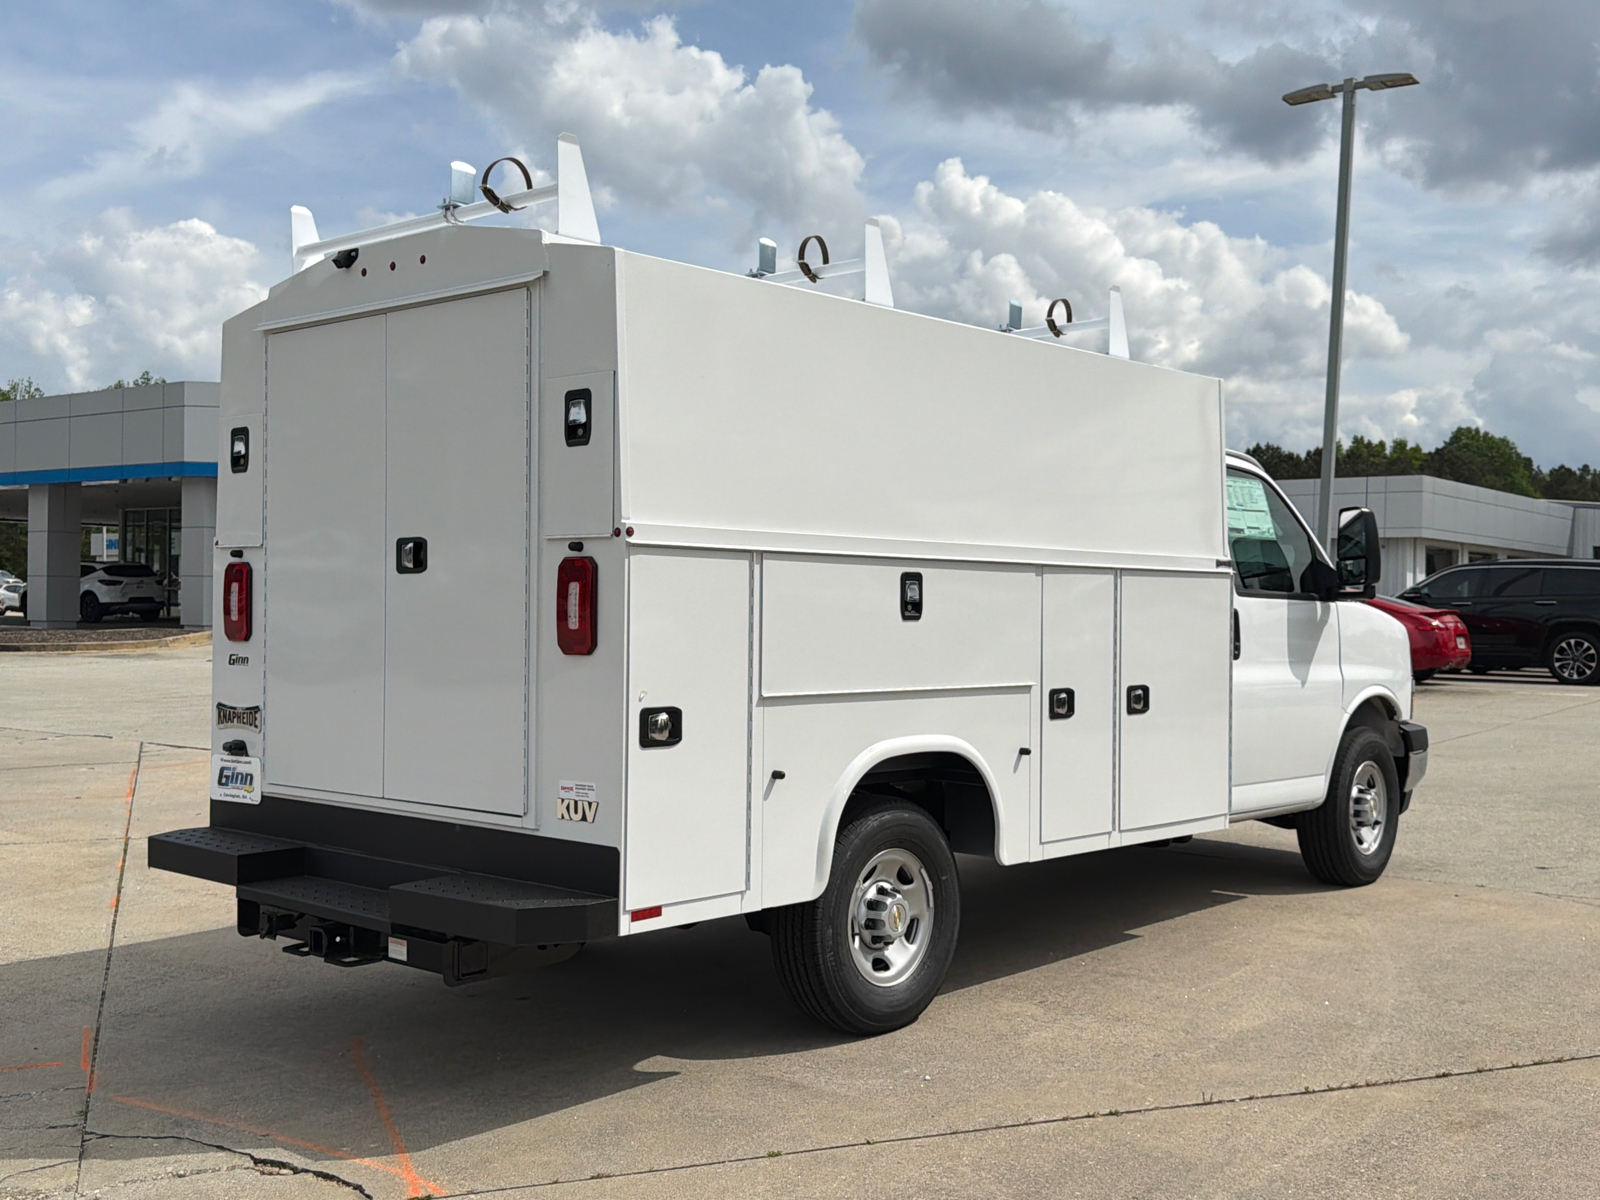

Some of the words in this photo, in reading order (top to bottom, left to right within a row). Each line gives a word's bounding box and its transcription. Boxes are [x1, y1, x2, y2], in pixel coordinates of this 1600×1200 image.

[228, 653, 249, 666] Ginn
[217, 707, 259, 729] KNAPHEIDE
[217, 766, 253, 787] Ginn
[556, 797, 599, 824] KUV
